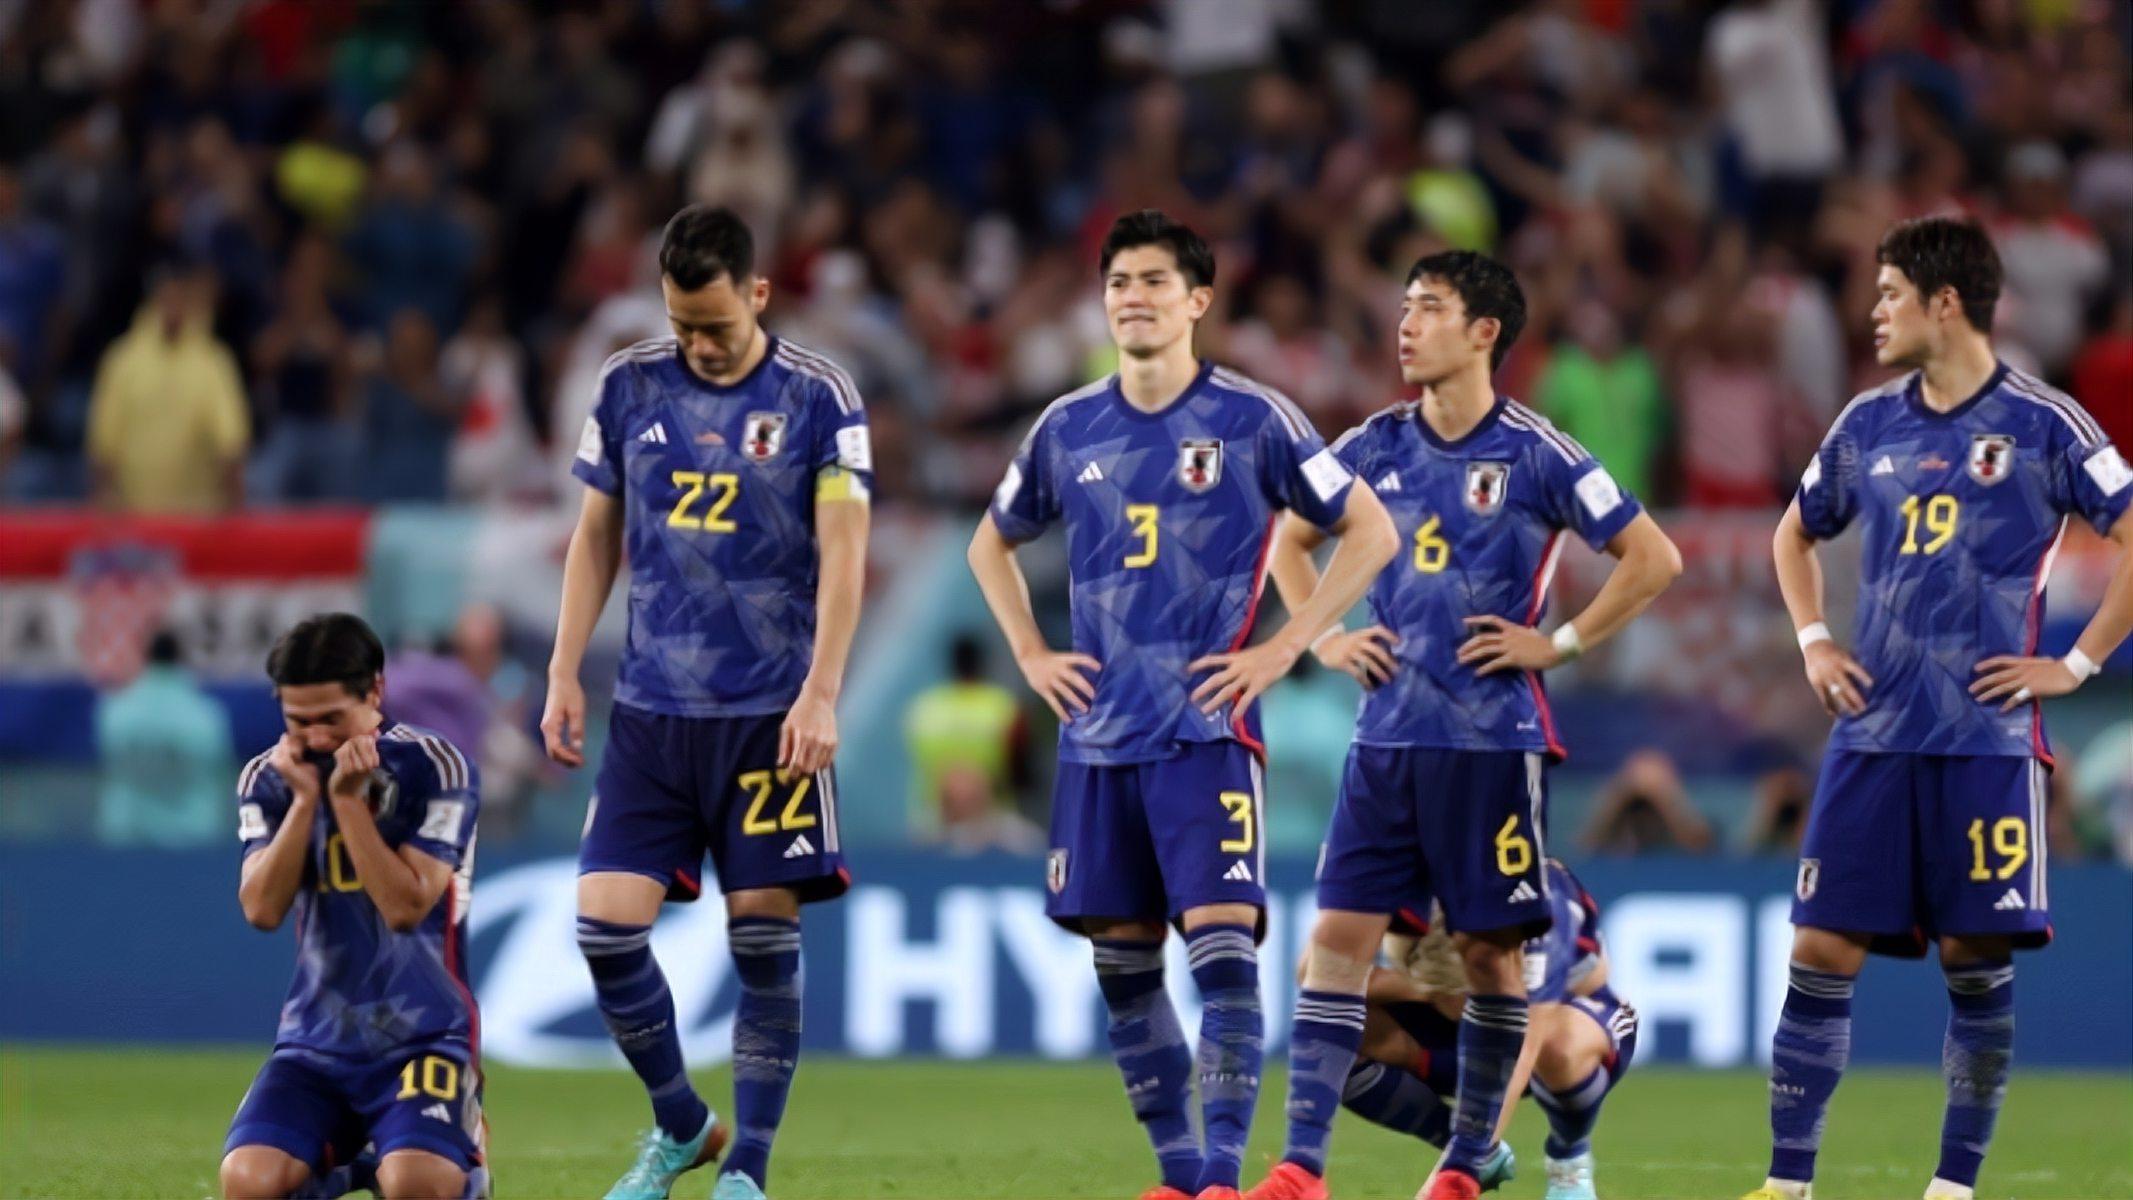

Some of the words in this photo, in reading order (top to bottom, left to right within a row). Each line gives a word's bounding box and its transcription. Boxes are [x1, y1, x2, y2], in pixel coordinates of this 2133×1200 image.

[667, 470, 738, 533] 22
[1900, 494, 1959, 555] 19
[1123, 503, 1160, 569] 3
[1413, 514, 1450, 574] 6
[738, 768, 817, 836] 22
[1219, 791, 1254, 853] 3
[318, 832, 365, 893] 0
[1494, 814, 1532, 876] 6
[1967, 816, 2028, 882] 19
[843, 884, 1796, 1062] HYAI
[396, 1055, 458, 1101] 10
